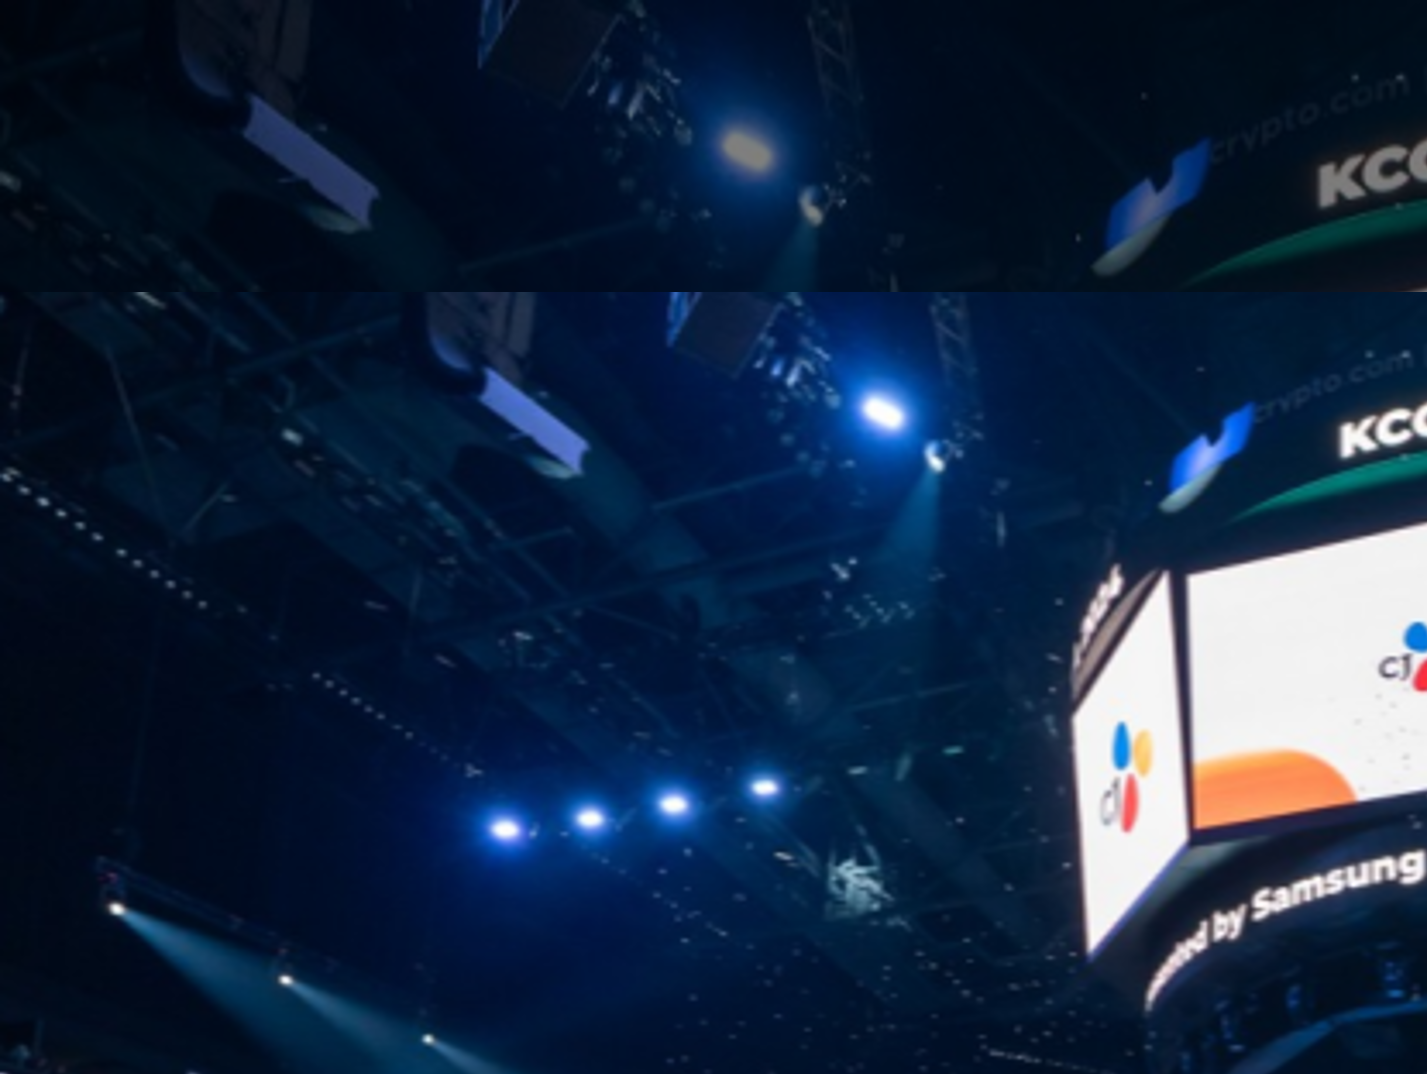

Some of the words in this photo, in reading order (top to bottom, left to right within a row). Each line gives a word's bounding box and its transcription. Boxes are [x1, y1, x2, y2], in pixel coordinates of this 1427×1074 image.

[1378, 652, 1413, 682] CJ
[1212, 904, 1248, 942] by
[1252, 848, 1427, 921] Samsung
